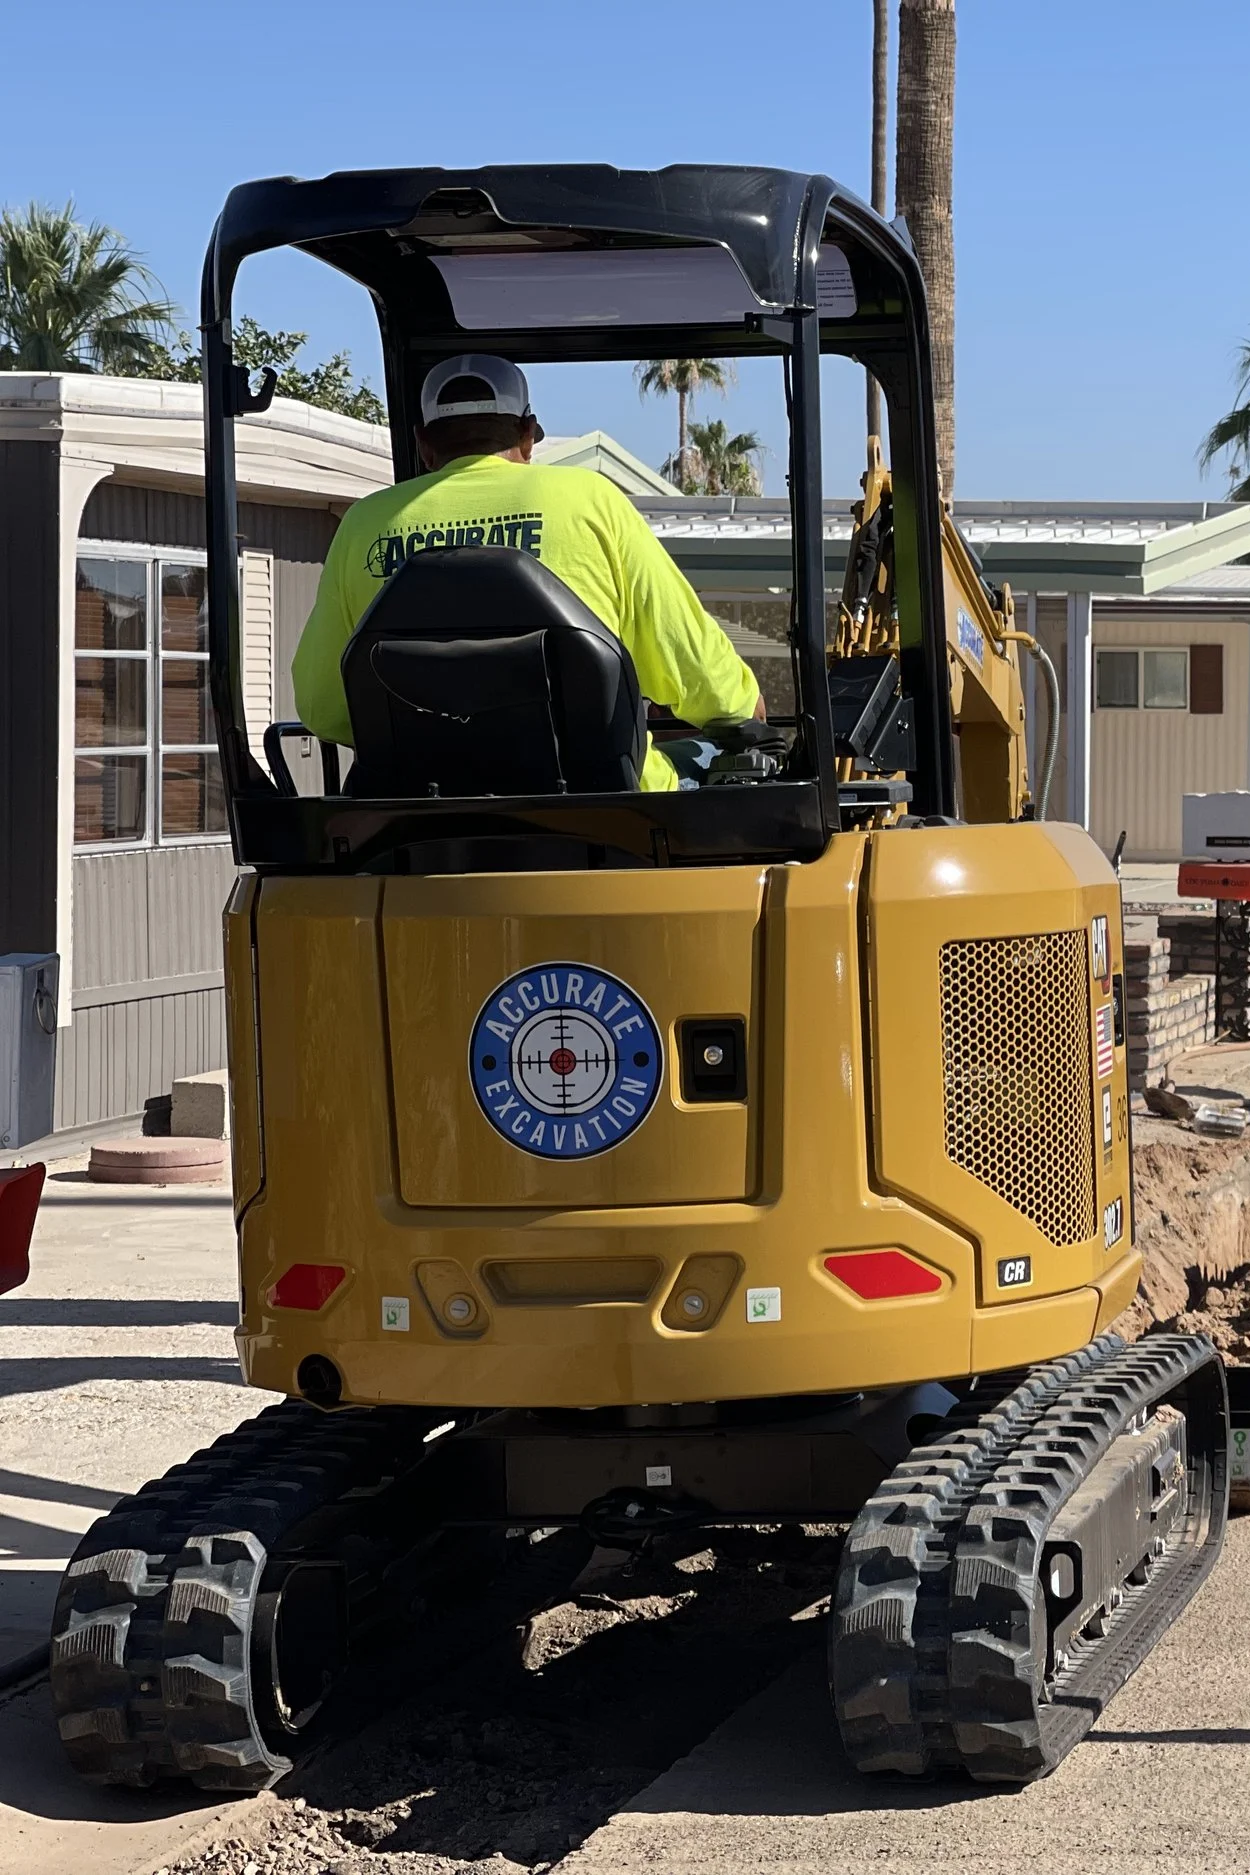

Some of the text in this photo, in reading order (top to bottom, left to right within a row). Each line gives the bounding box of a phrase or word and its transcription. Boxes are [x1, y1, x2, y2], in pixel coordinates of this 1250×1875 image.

[1091, 917, 1107, 978] CAT
[485, 973, 644, 1043] ACCURATE
[485, 1077, 649, 1150] EXCAVATION
[1004, 1260, 1025, 1283] CR
